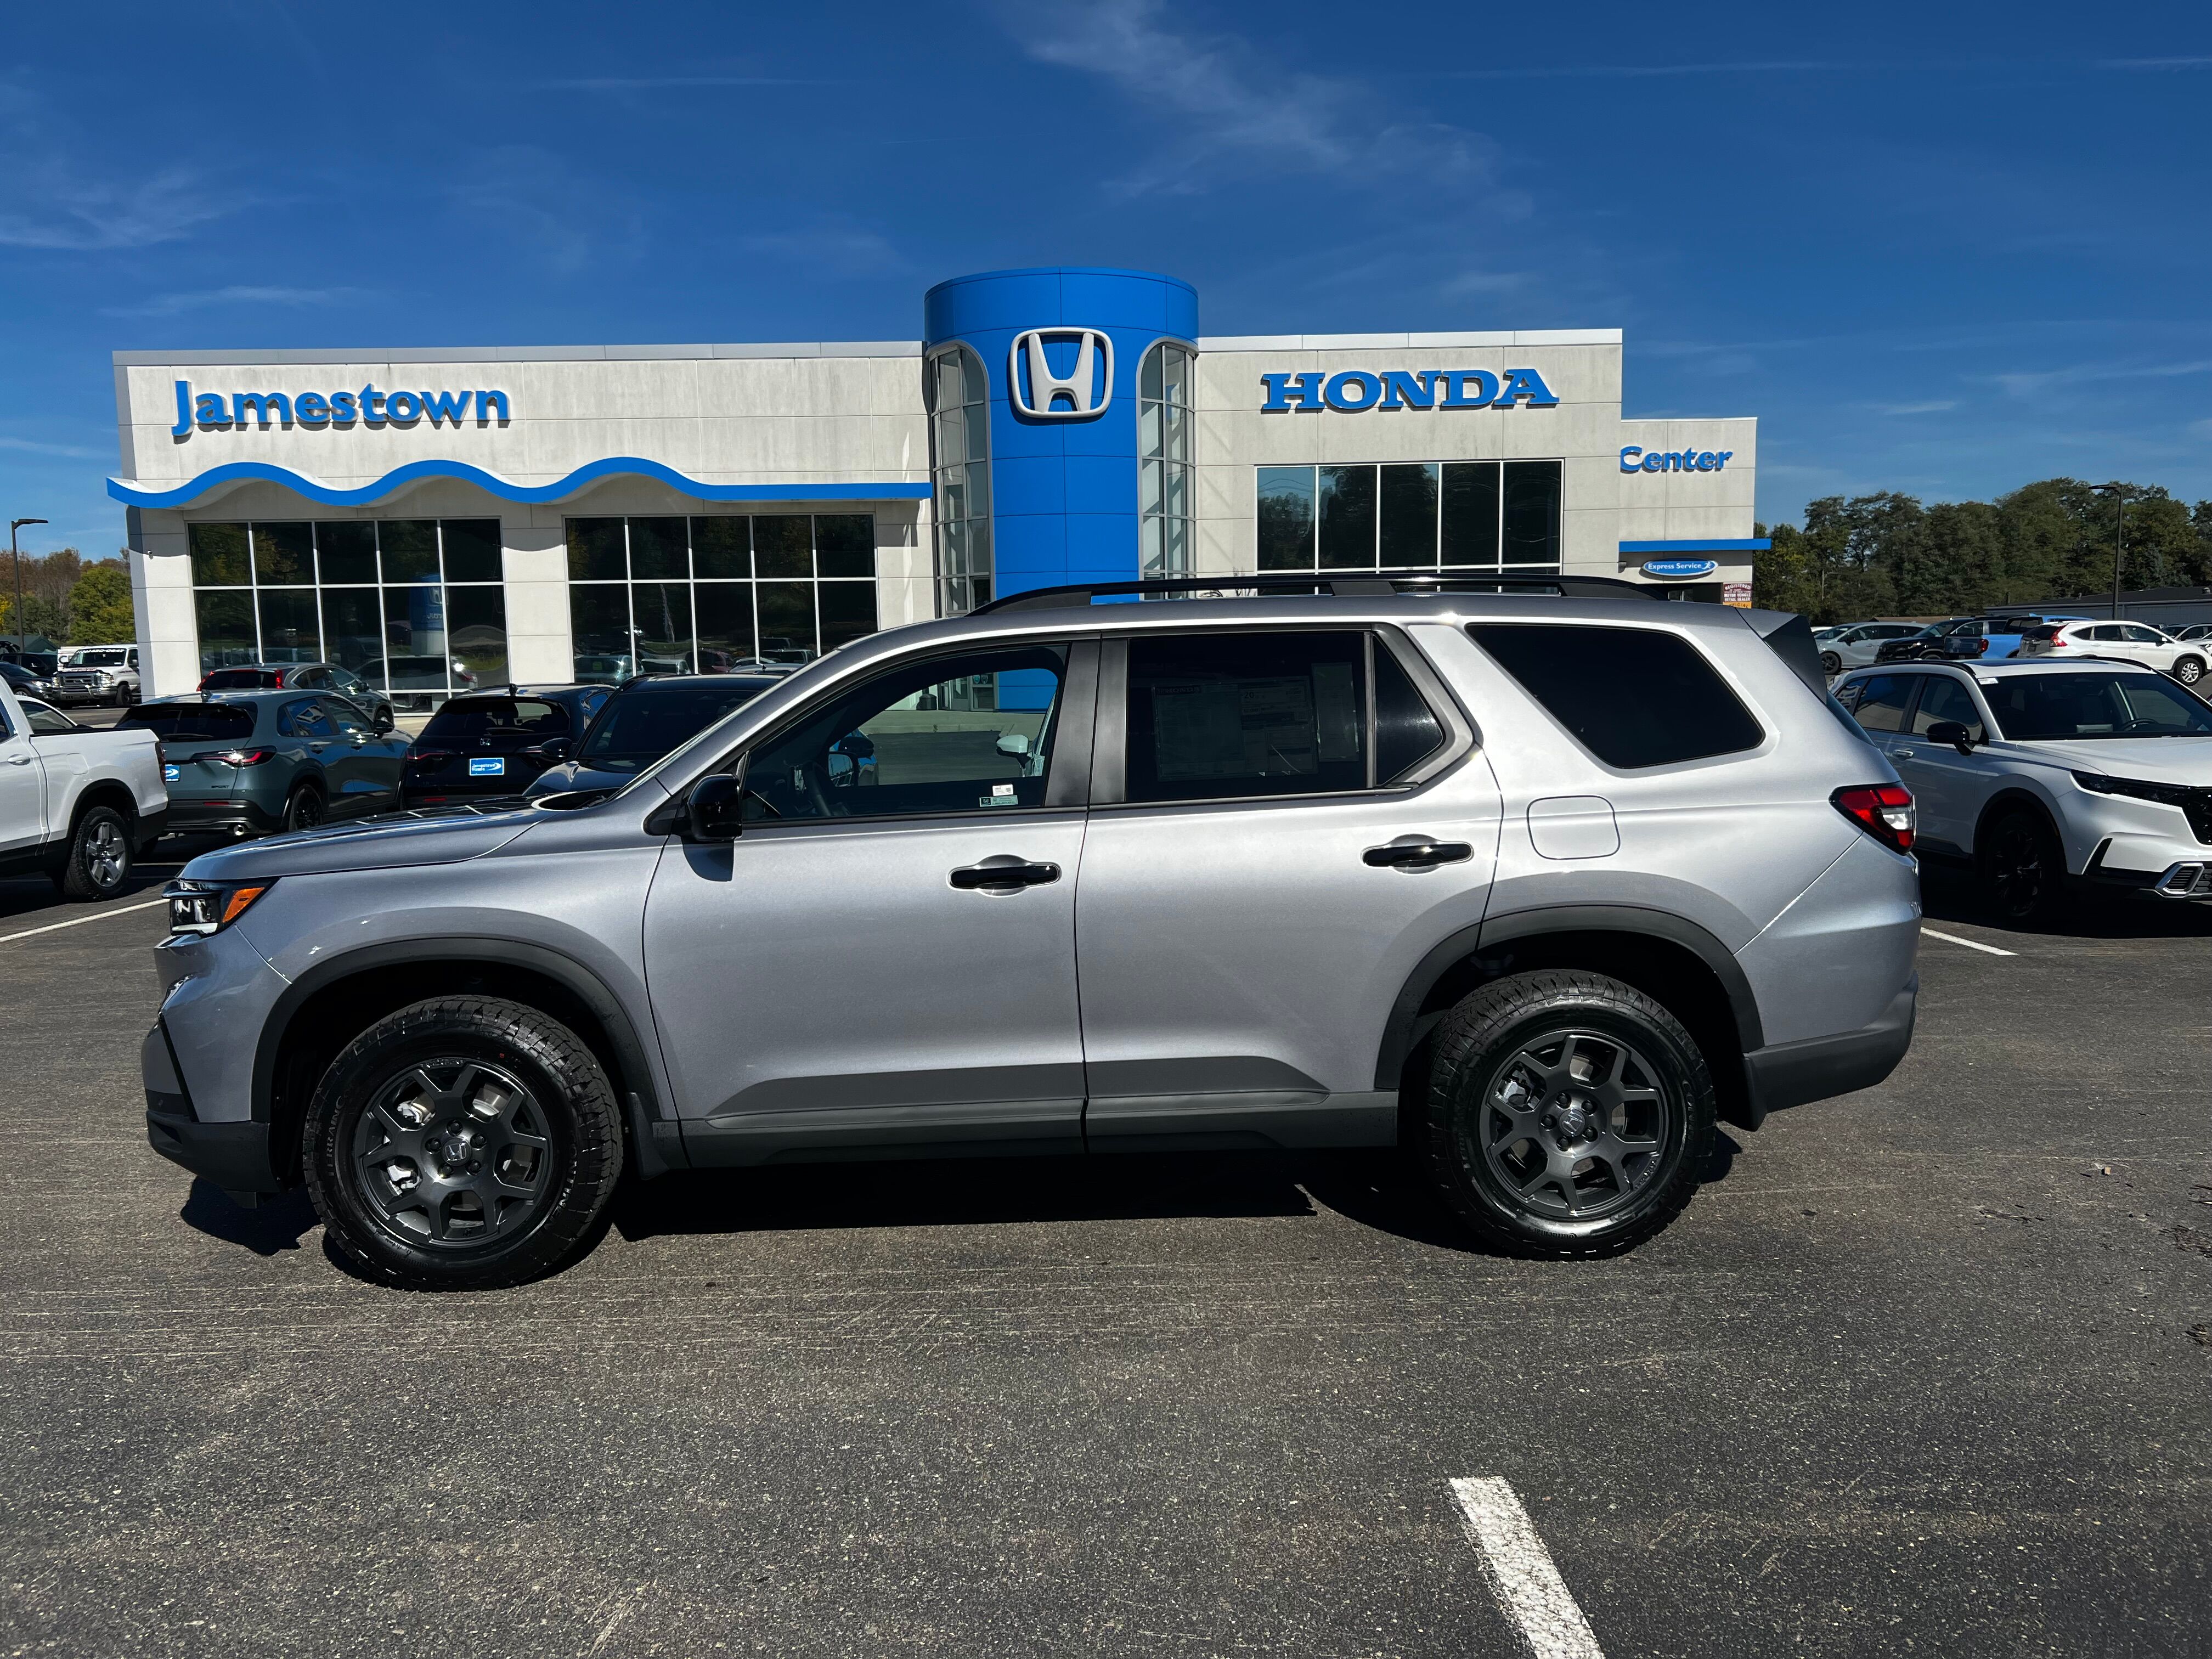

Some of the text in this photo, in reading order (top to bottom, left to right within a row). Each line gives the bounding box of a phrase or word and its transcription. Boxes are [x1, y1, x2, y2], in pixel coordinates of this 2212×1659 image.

[171, 380, 510, 437] Jamestown
[1262, 368, 1560, 409] HONDA
[1620, 445, 1734, 471] Center
